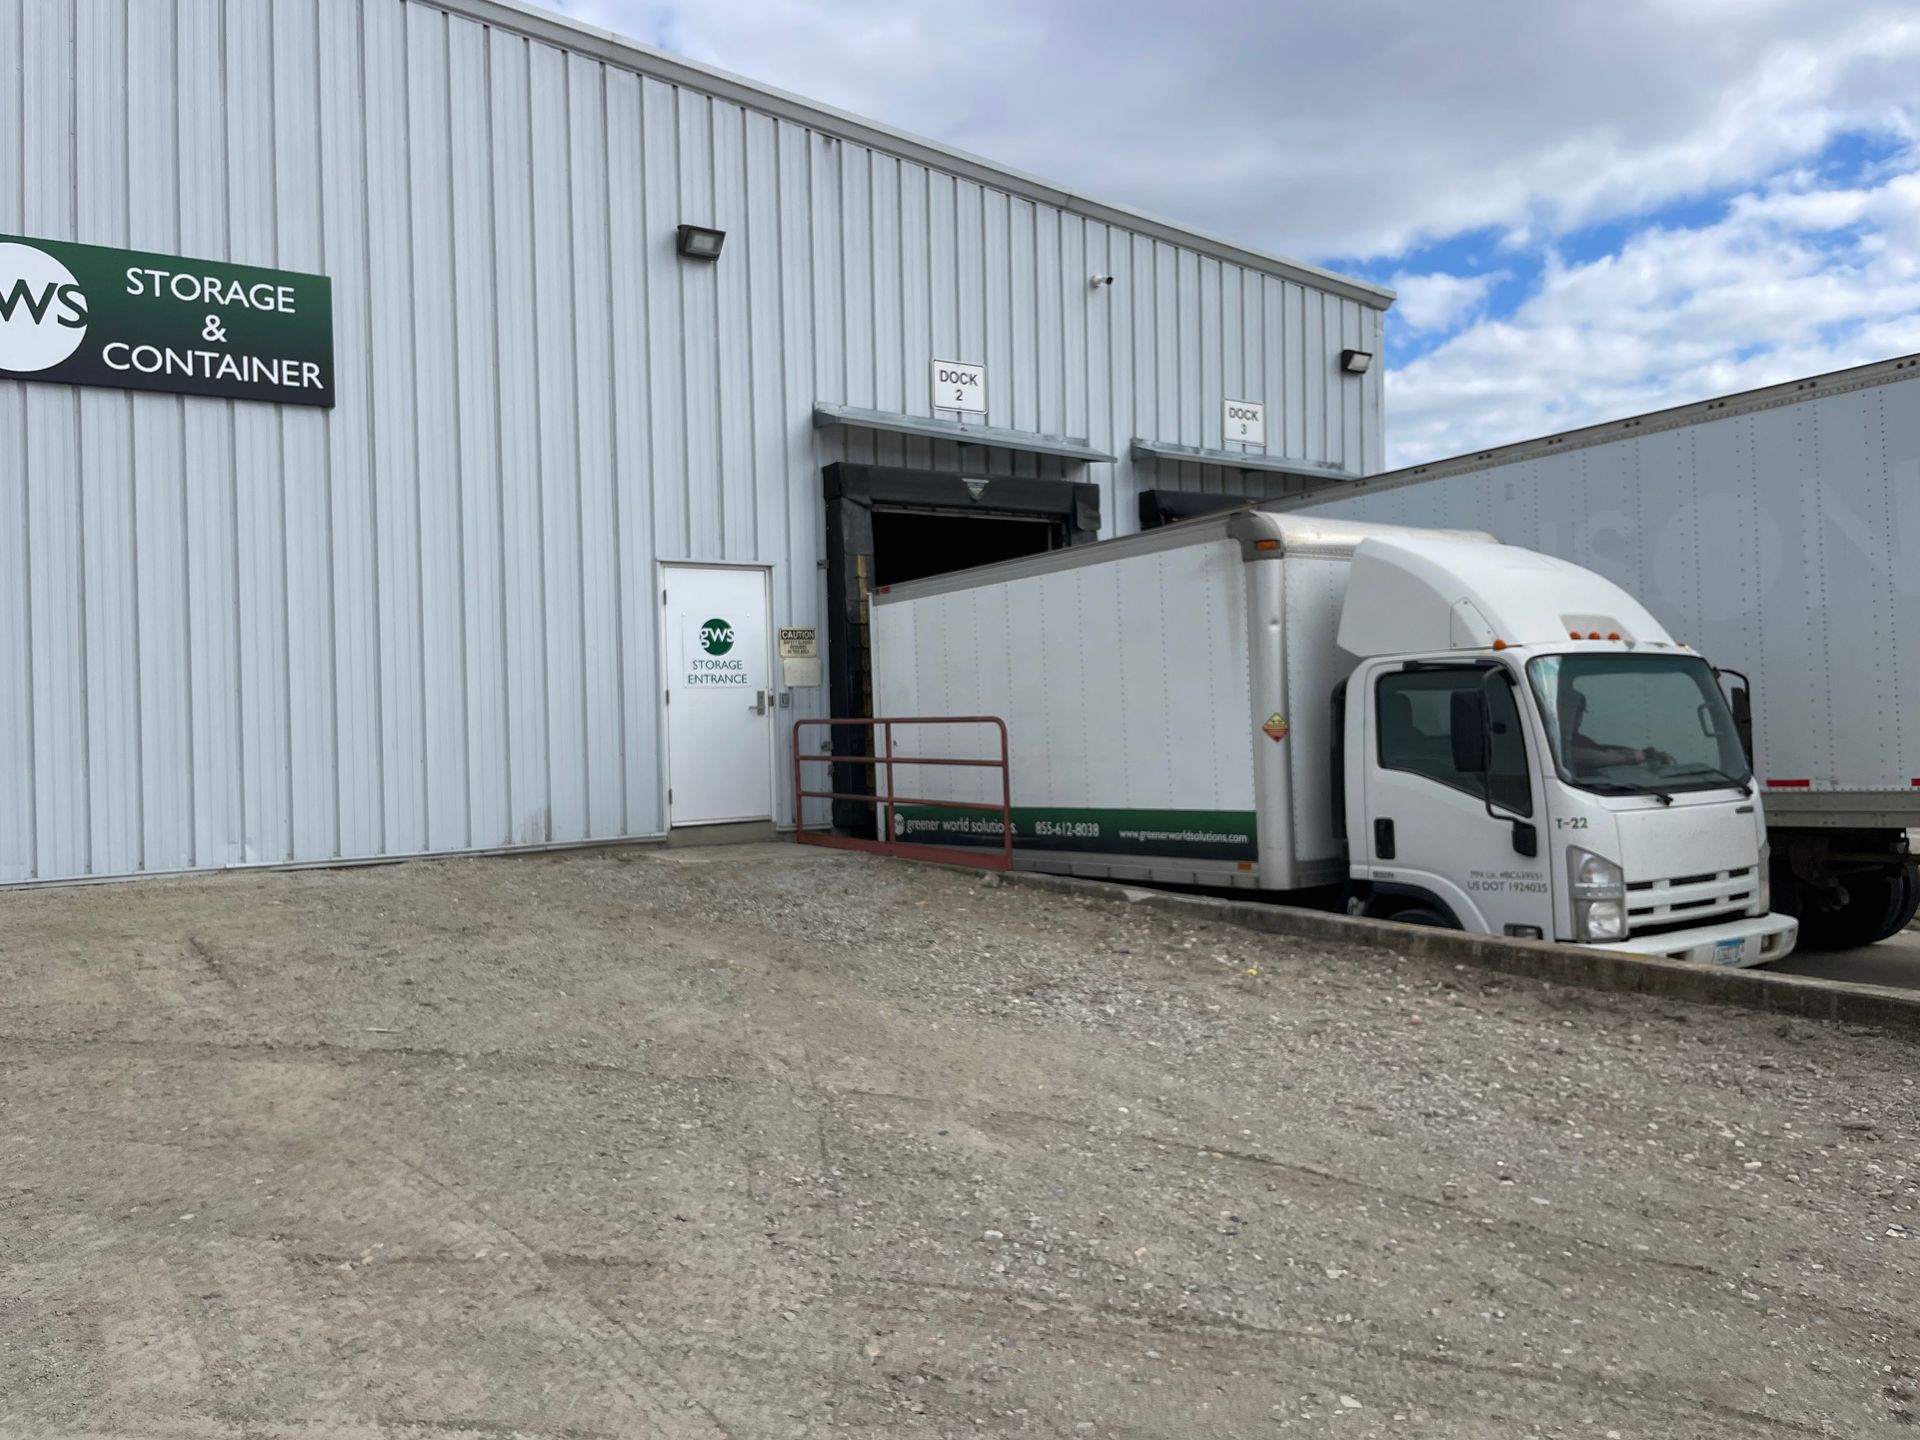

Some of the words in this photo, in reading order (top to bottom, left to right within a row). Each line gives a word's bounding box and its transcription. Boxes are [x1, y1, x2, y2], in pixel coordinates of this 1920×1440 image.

[125, 266, 296, 314] STORAGE
[202, 314, 228, 342] &
[102, 342, 324, 389] CONTAINER
[939, 369, 978, 387] DOCK
[955, 389, 963, 401] 2
[1229, 407, 1259, 422] DOCK
[1240, 423, 1247, 435] 3
[781, 630, 815, 639] CAUTION
[692, 660, 743, 670] STORAGE
[688, 674, 747, 684] ENTRANCE
[906, 818, 940, 833] greener
[943, 817, 970, 832] world
[1035, 821, 1100, 837] 855-612-8038
[1555, 817, 1588, 830] T-22
[1119, 830, 1248, 843] www.greenerworldsolutions.com
[1467, 881, 1480, 891] US
[1482, 881, 1505, 891] DOT
